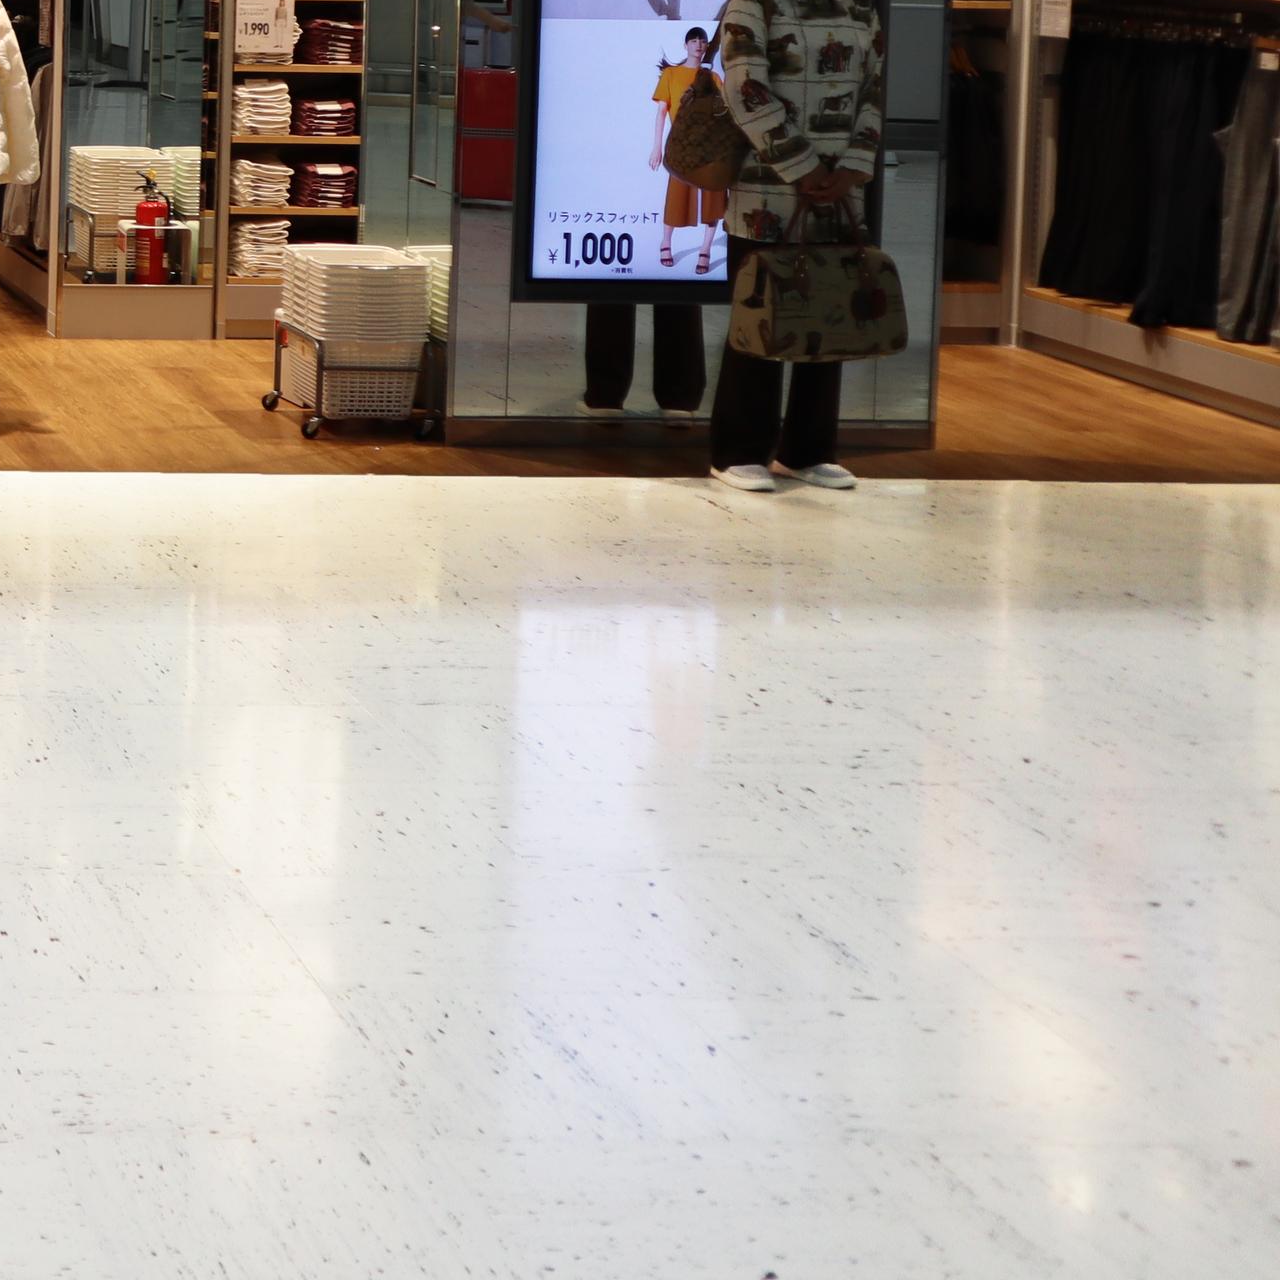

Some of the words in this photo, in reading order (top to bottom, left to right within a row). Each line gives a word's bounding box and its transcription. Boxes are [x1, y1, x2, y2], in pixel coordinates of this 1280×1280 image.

[548, 211, 660, 223] リラックスフィットT
[548, 232, 633, 268] ¥1,000
